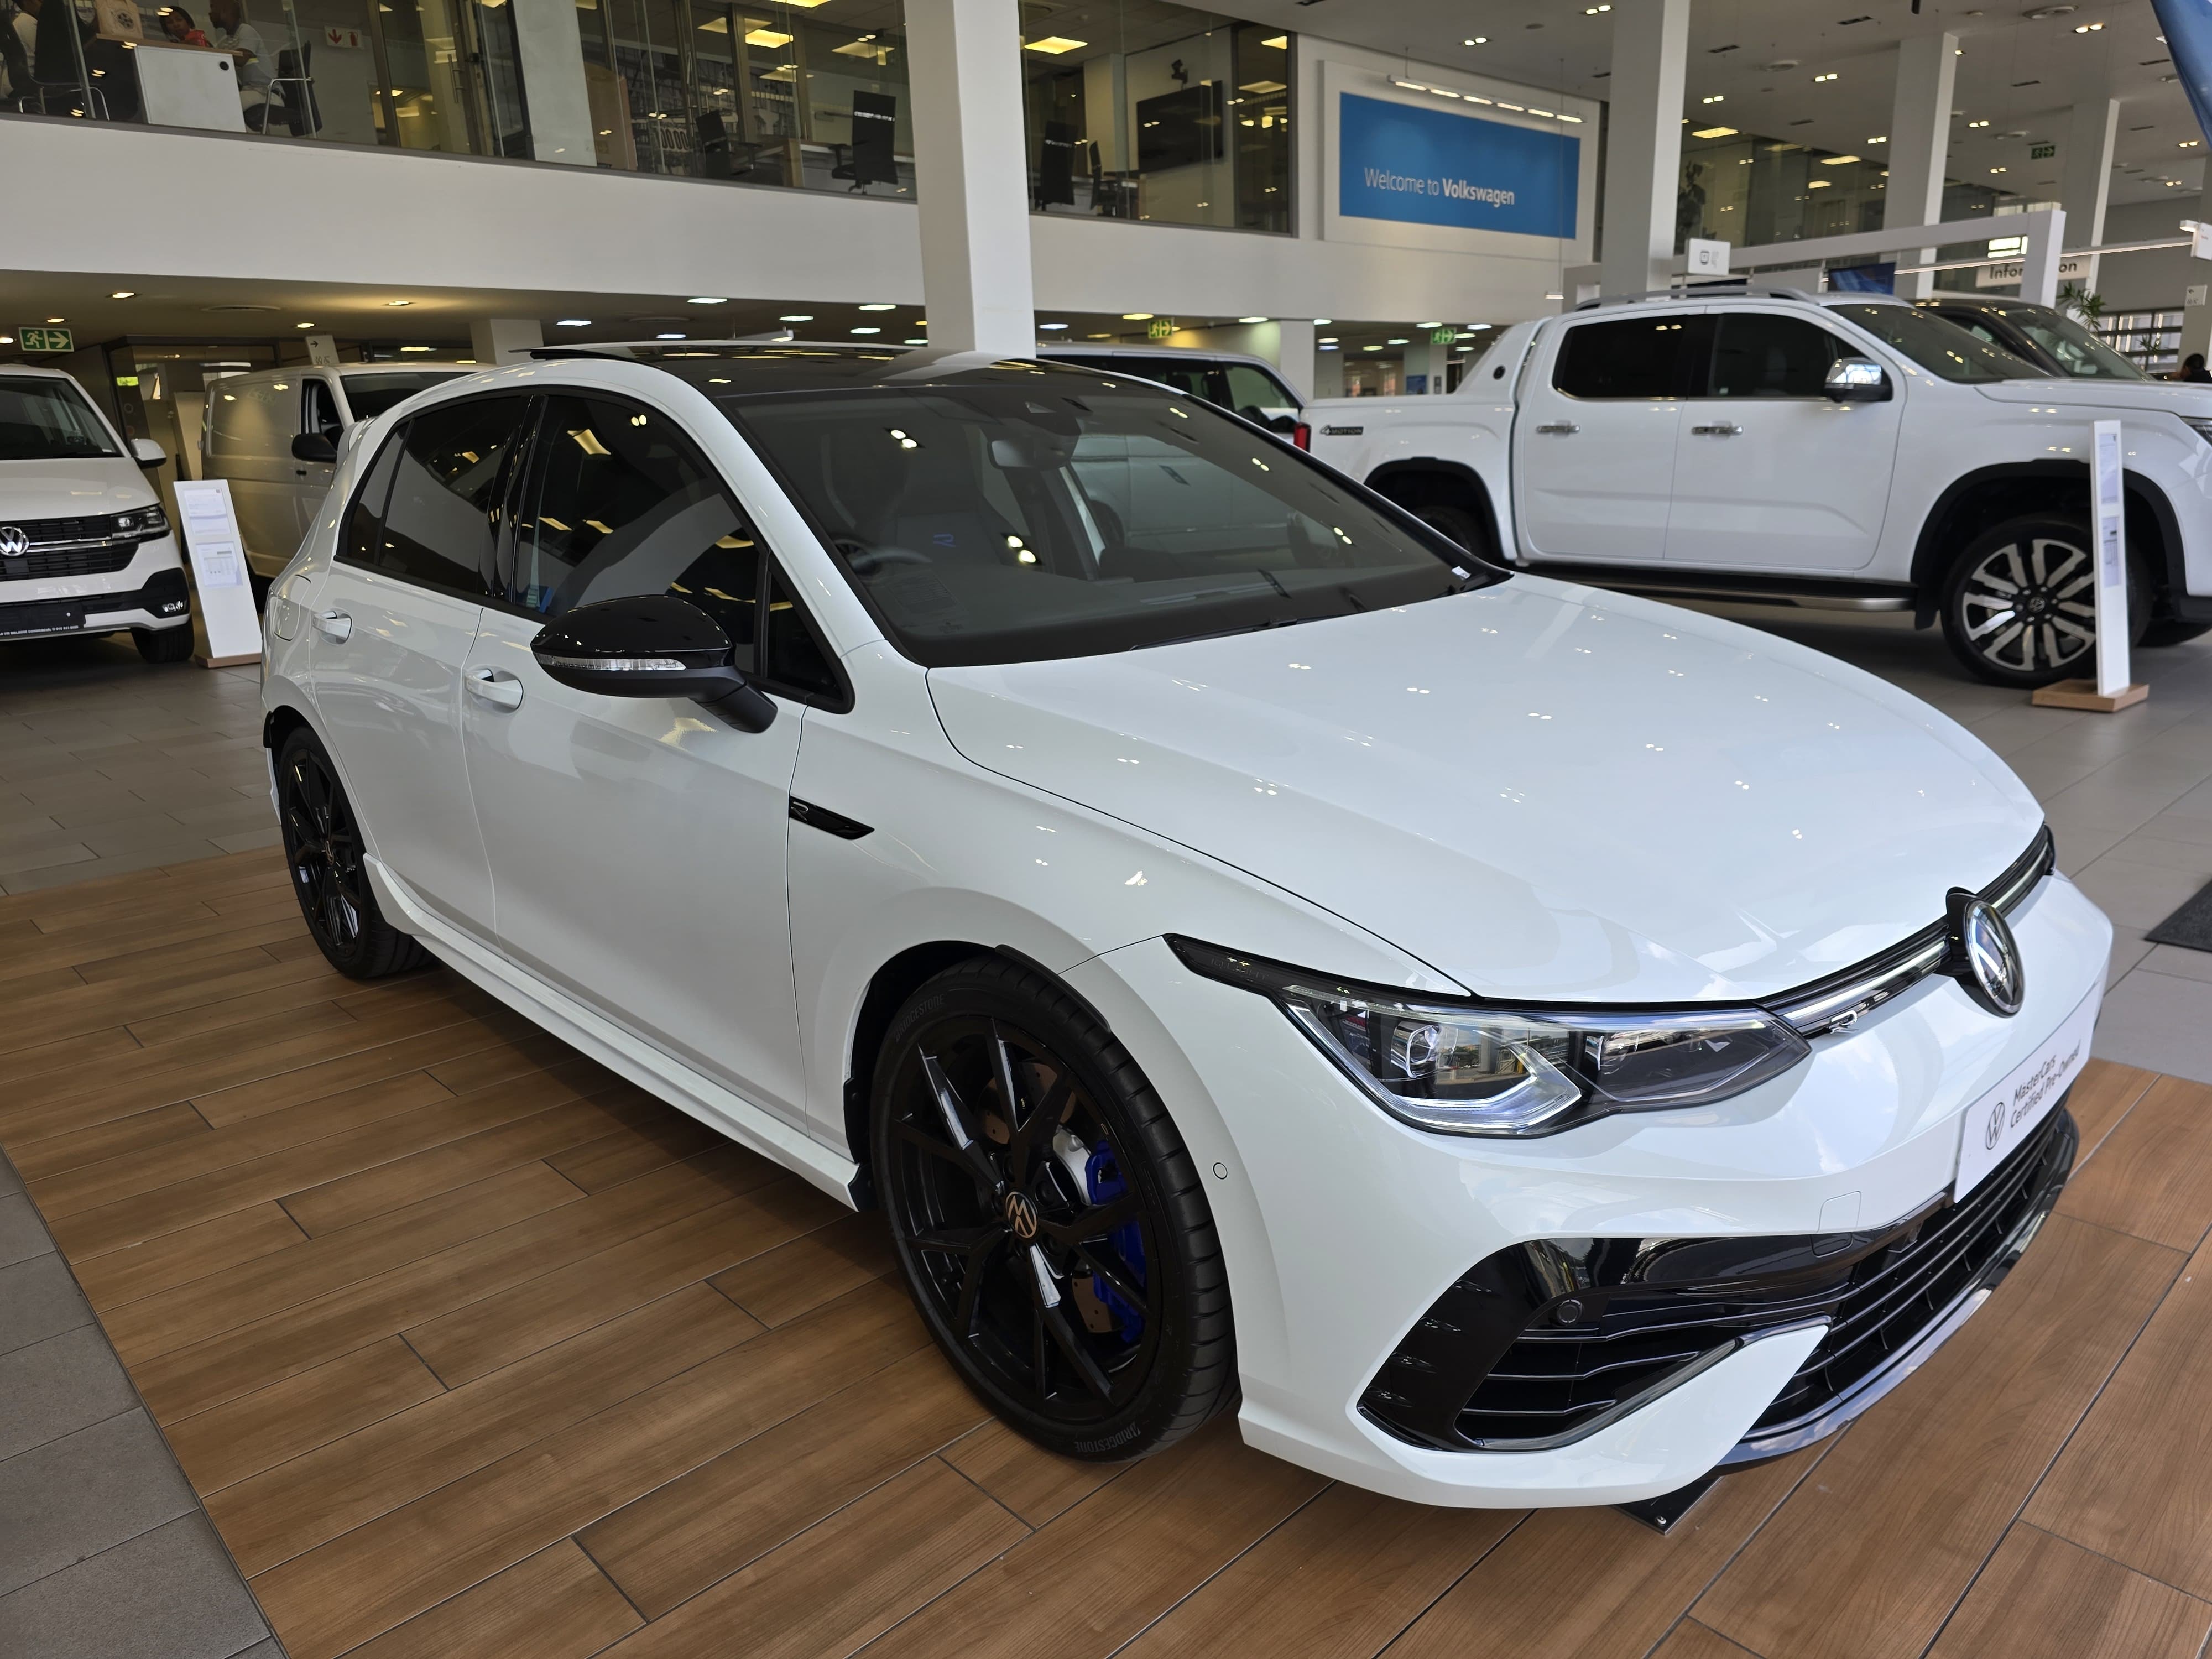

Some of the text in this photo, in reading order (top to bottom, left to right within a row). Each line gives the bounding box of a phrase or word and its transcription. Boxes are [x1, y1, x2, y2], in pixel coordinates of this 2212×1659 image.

[1364, 167, 1515, 208] Welcome to Volkswagen
[1989, 262, 2078, 279] Inforon
[790, 801, 808, 821] R
[894, 993, 947, 1043] BRIDGESTONE
[2011, 1039, 2081, 1128] Certified Pre-Owned
[2013, 1054, 2057, 1107] MasterCars
[1074, 1420, 1141, 1453] BRIDGESTONE
